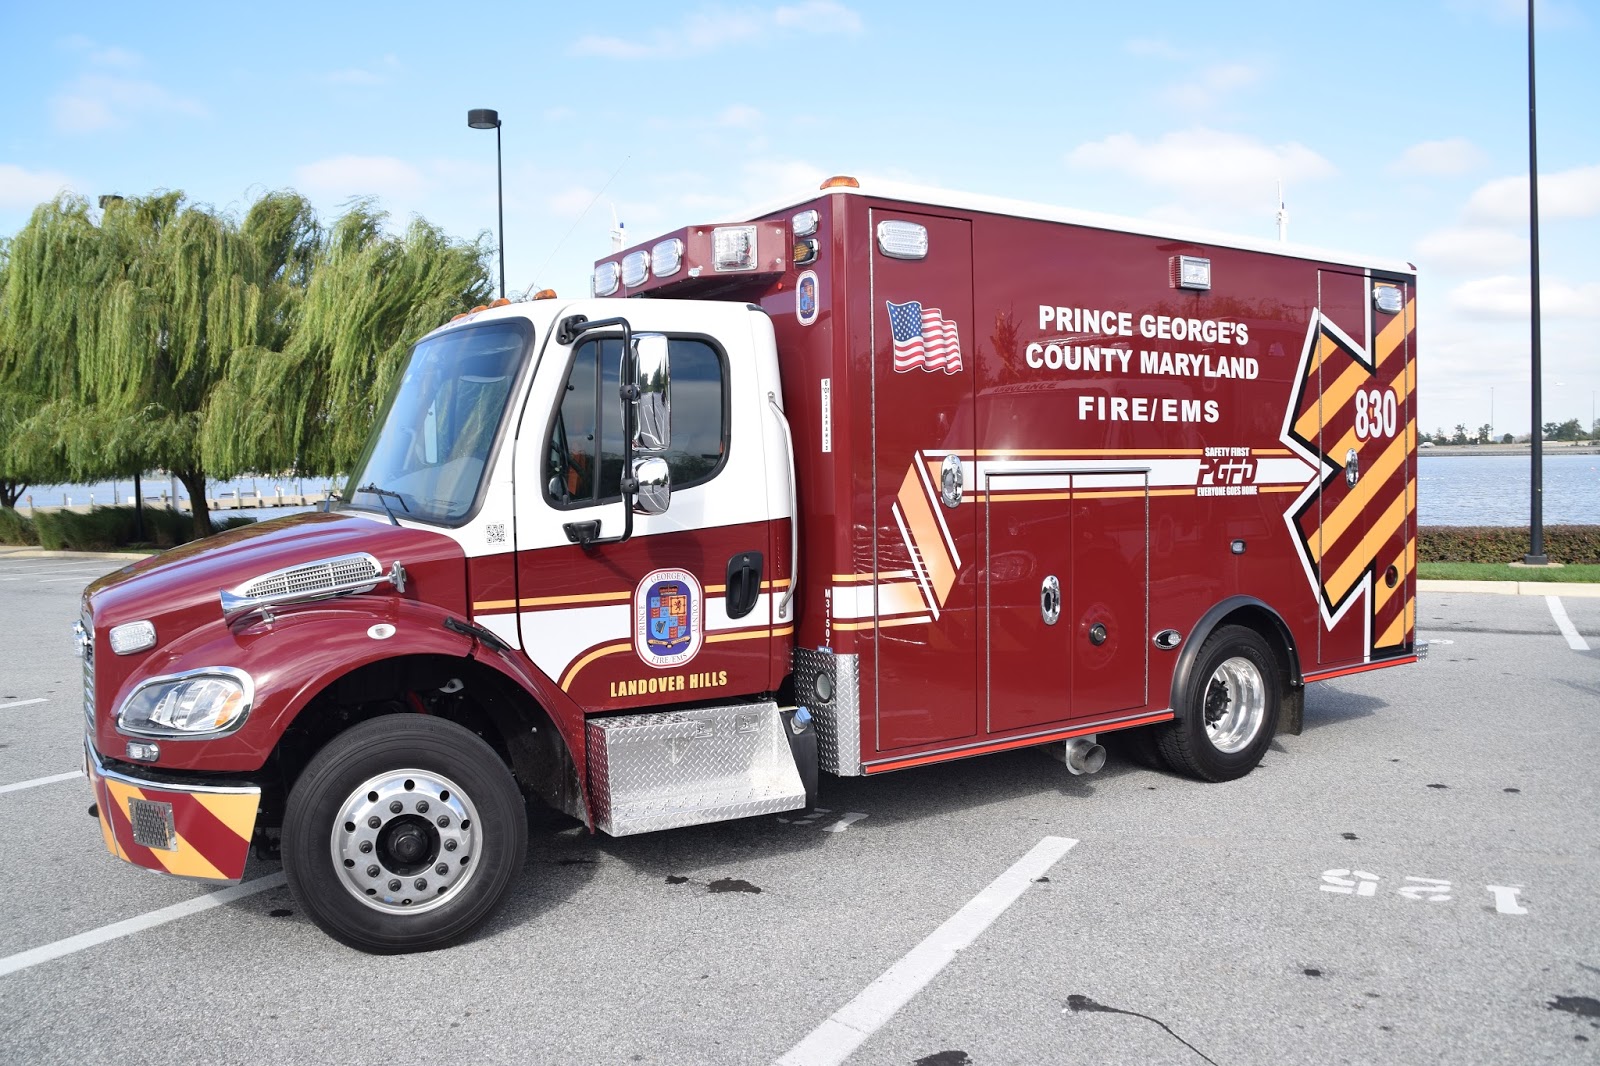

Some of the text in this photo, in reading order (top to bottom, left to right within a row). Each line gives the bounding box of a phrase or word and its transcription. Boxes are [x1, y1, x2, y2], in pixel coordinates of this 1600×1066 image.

[1038, 304, 1249, 346] PRINCE GEORGE'S
[1025, 342, 1259, 380] COUNTY MARYLAND
[1078, 396, 1220, 423] FIRE/EMS
[1355, 389, 1397, 438] 830
[1204, 447, 1250, 457] SAFETY FIRST
[1196, 485, 1258, 497] EVERYONE GOES HOME
[650, 572, 688, 584] GEORGE'S
[691, 599, 699, 634] COUNTY
[651, 653, 688, 664] FIRE/EMS
[610, 670, 728, 698] LANDOVER HILLS
